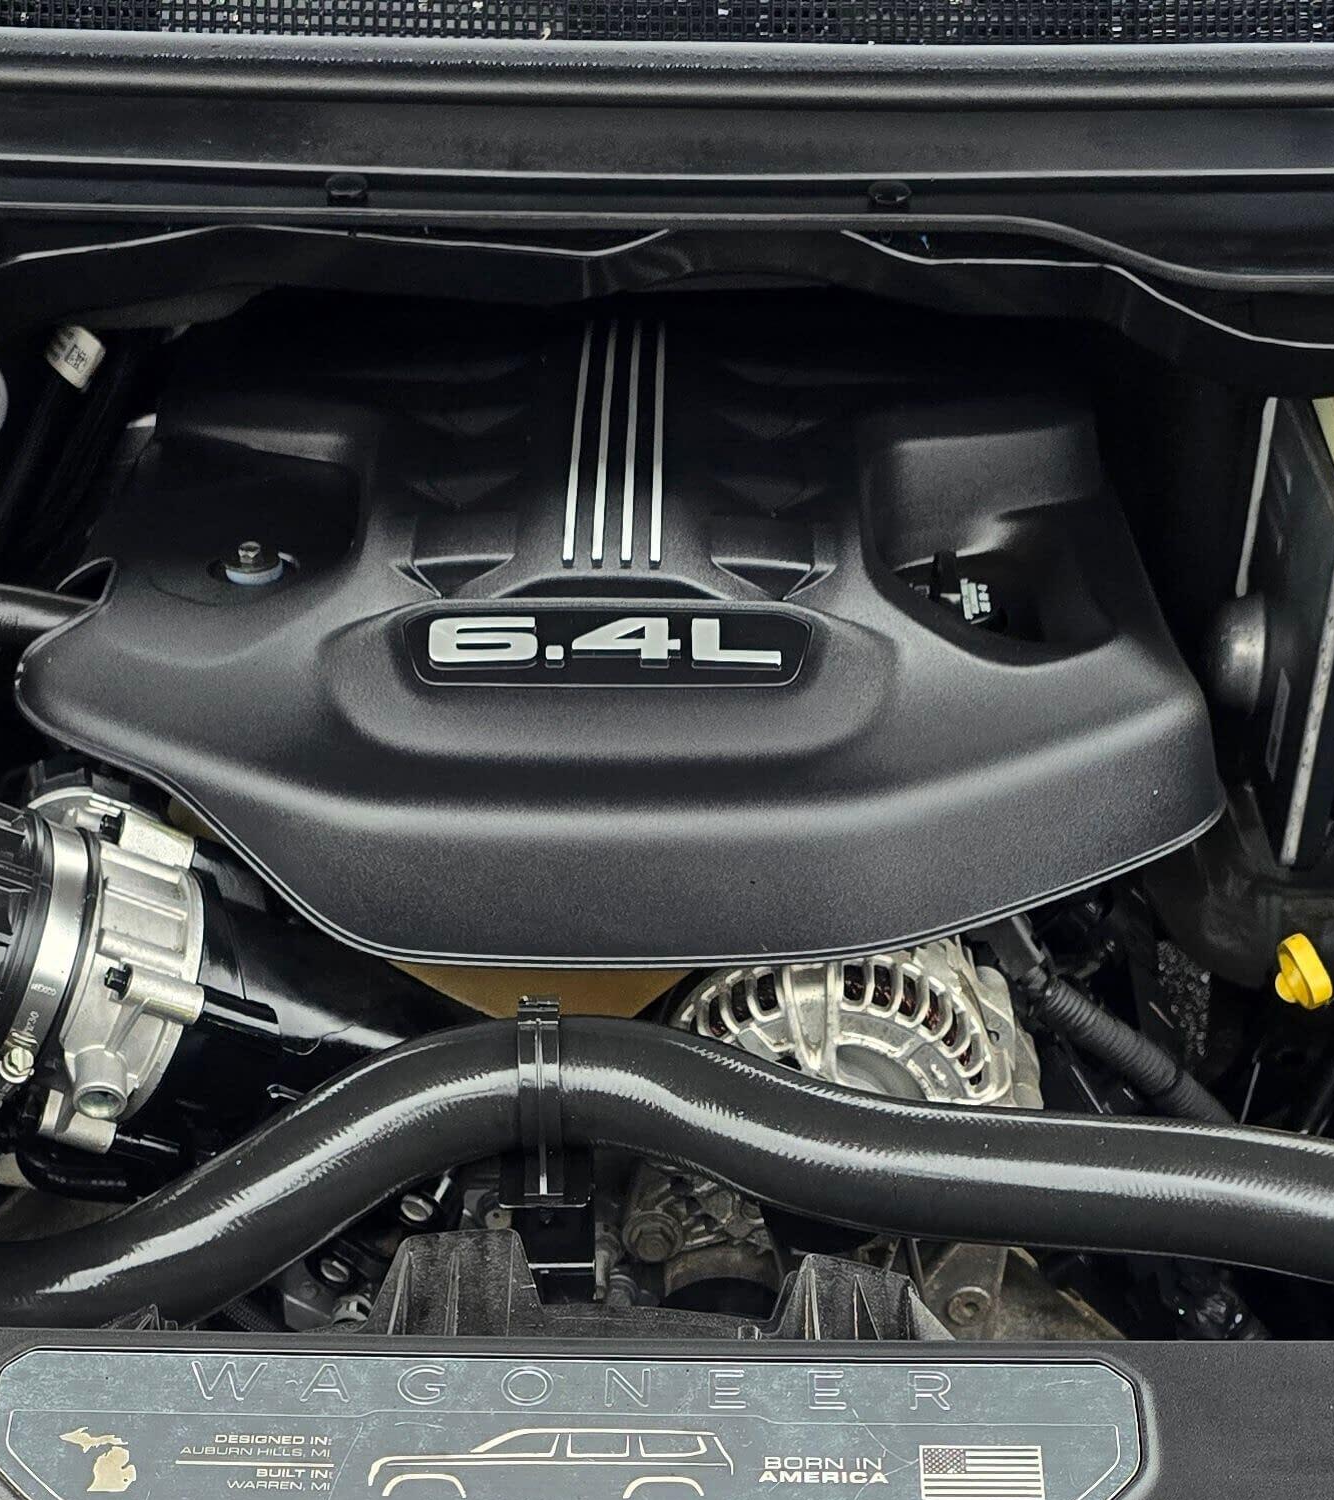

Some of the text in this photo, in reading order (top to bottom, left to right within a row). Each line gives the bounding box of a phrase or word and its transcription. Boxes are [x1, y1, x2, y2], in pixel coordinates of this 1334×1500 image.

[428, 616, 782, 668] 6.4L
[191, 1360, 952, 1411] WAGONEER
[214, 1434, 305, 1445] DESIGNED
[179, 1446, 253, 1456] AUBURN
[310, 1449, 331, 1458] MI
[763, 1456, 883, 1471] BORN IN
[256, 1468, 306, 1479] BUILT
[758, 1471, 890, 1484] AMERICA
[227, 1479, 331, 1492] WARREN, MI
